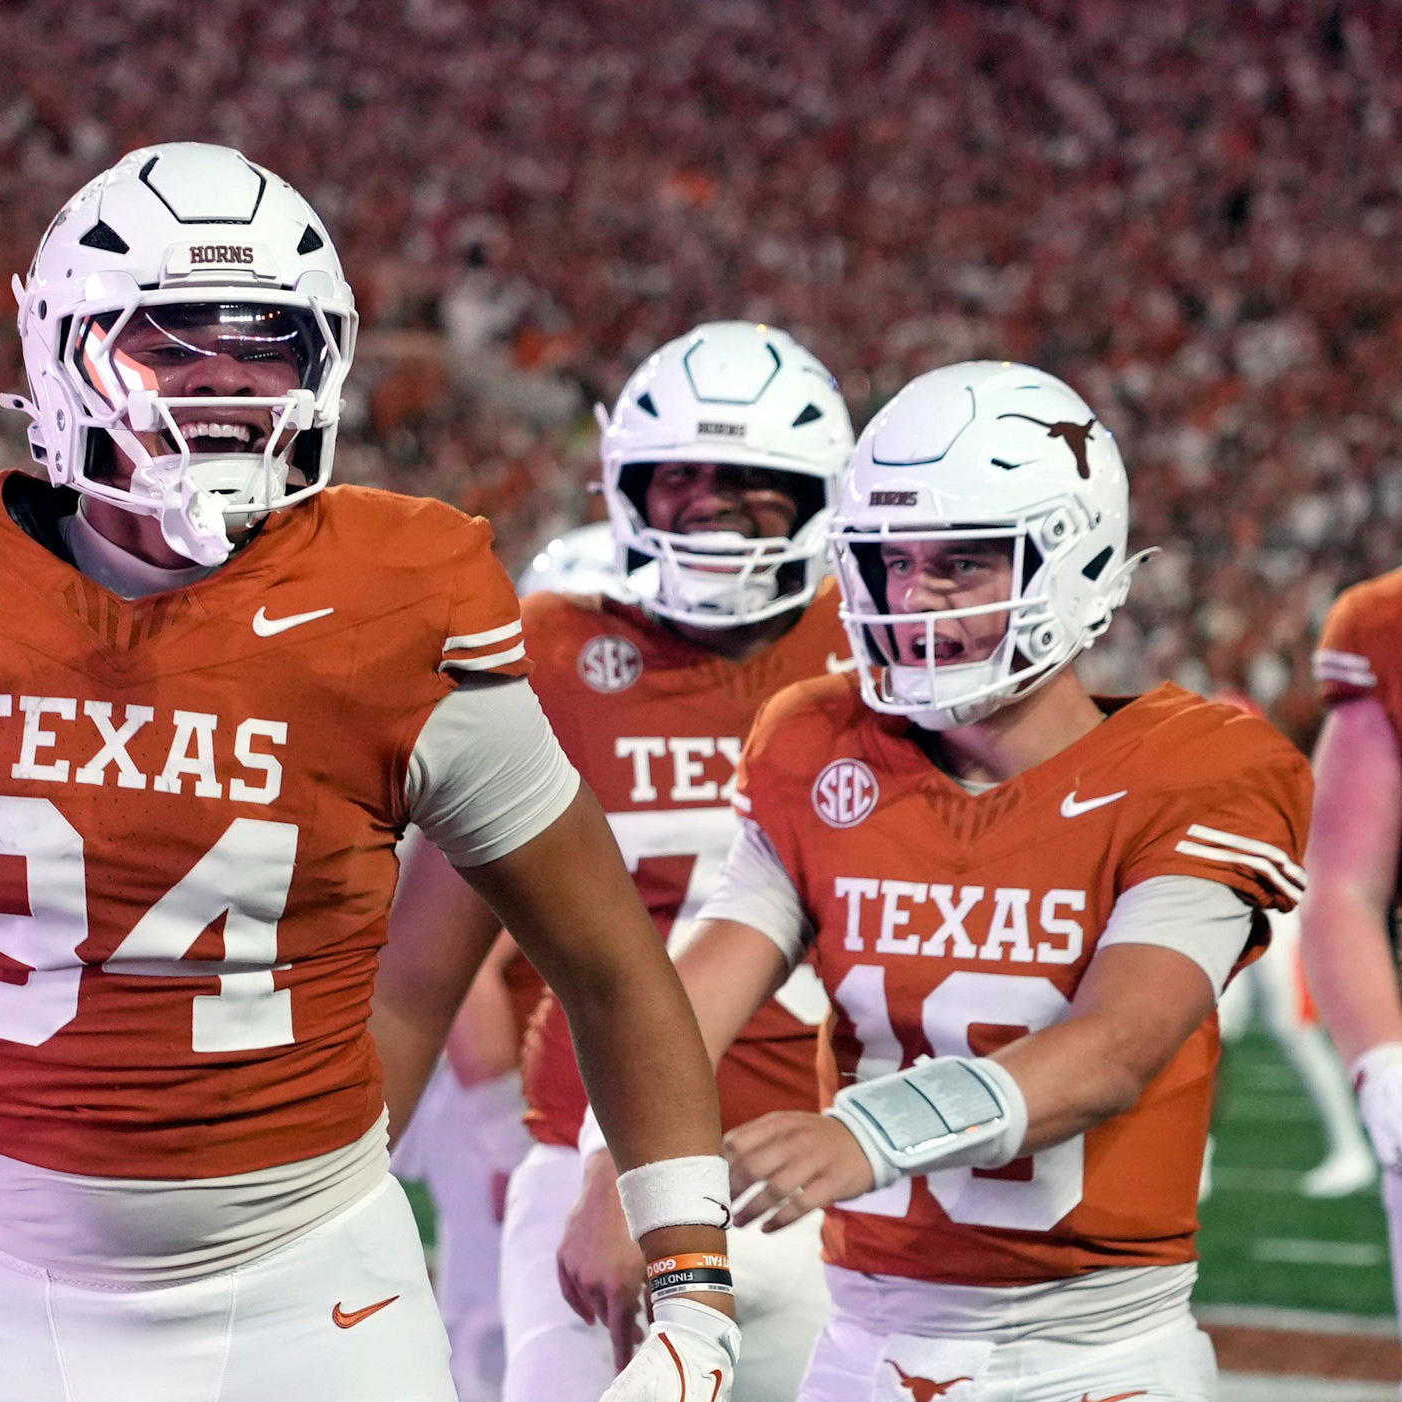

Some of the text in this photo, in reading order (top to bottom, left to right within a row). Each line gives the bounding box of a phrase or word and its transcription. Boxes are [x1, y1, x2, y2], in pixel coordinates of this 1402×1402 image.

[190, 246, 254, 264] HORNS
[582, 639, 639, 690] SEC
[818, 763, 872, 823] SEC
[834, 876, 1087, 965] TEXAS
[653, 1259, 676, 1273] GOD
[668, 1272, 693, 1284] FIND
